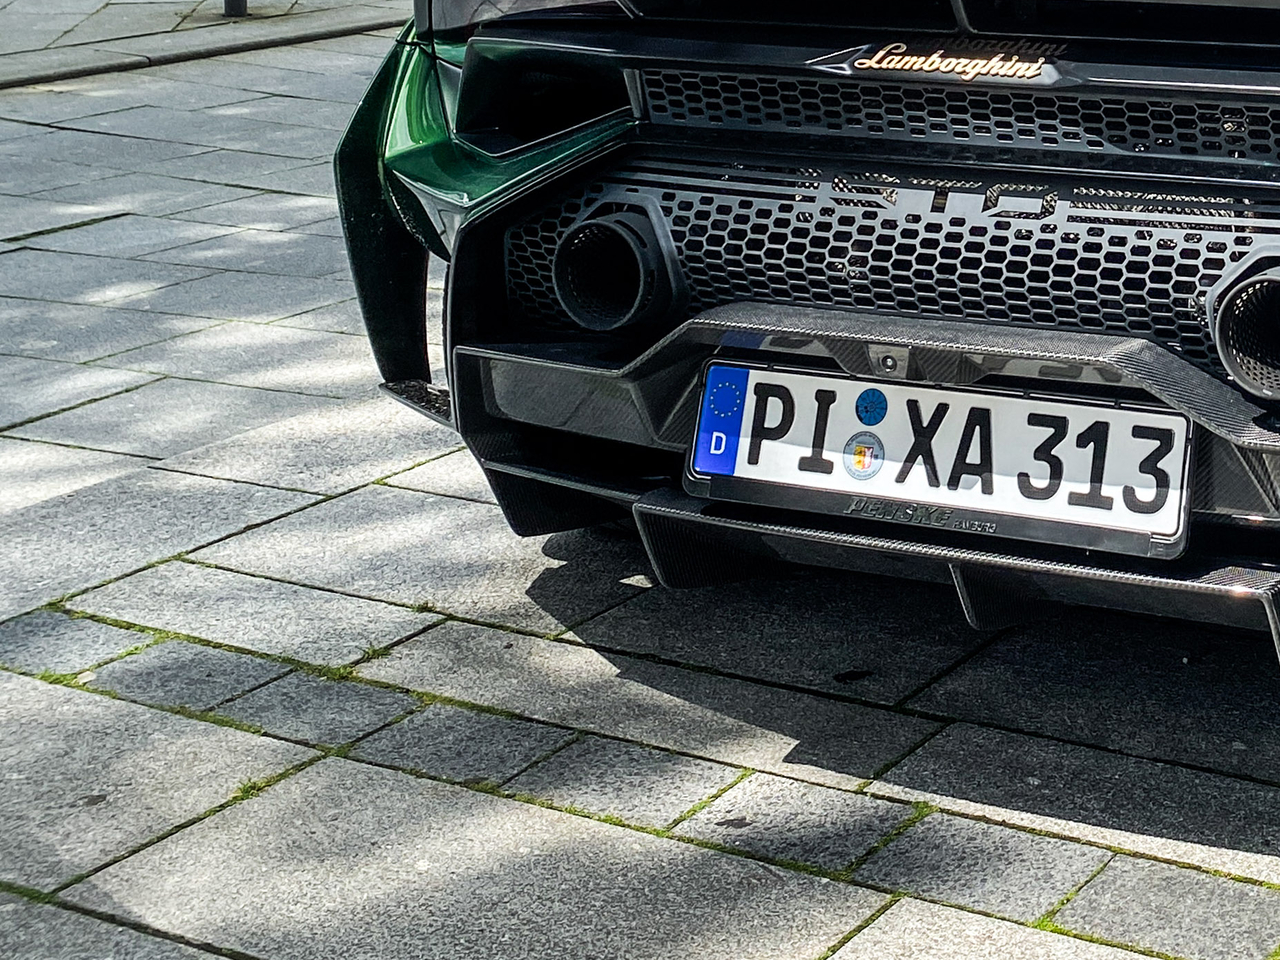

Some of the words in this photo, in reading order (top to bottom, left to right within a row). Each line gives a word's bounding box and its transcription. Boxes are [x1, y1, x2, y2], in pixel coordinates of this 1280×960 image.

[853, 42, 1047, 81] Lamborghini
[830, 172, 1058, 221] STO
[709, 431, 726, 455] D
[747, 382, 837, 474] PI
[894, 399, 995, 495] XA
[1017, 412, 1176, 515] 313
[843, 496, 953, 527] PENSKE
